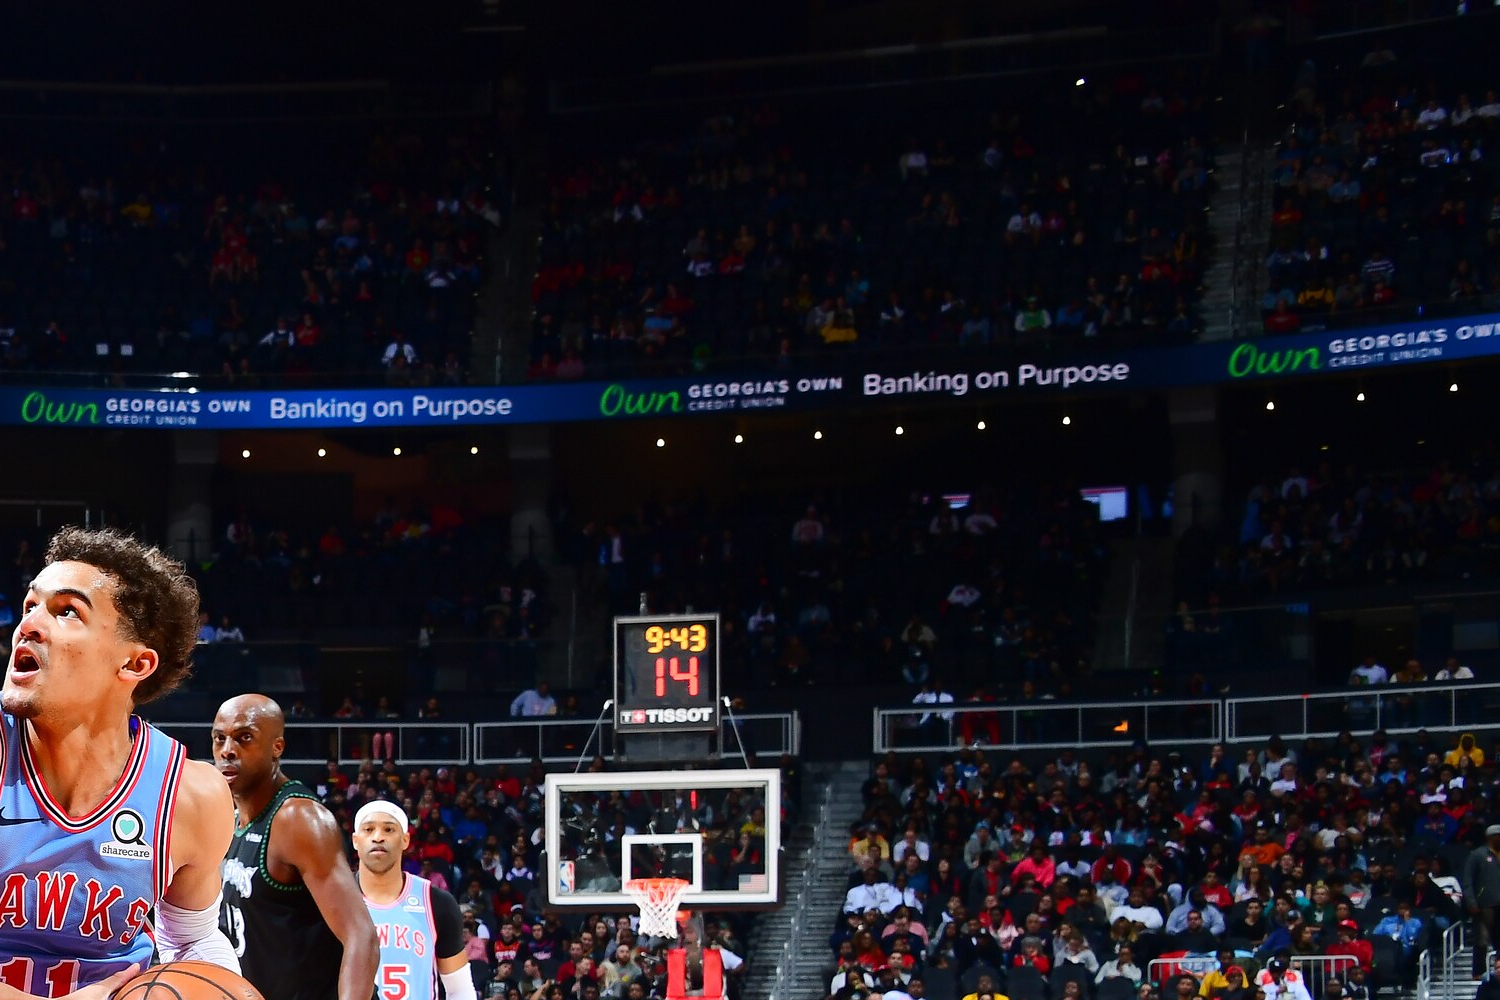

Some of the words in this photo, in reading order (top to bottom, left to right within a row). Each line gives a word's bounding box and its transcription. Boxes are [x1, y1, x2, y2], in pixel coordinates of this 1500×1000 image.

[1329, 327, 1448, 355] GEORGIA'S
[1228, 341, 1320, 379] Own
[1329, 351, 1382, 368] CREDIT
[1390, 346, 1443, 363] UNION
[688, 378, 791, 400] GEORGIA'S
[796, 376, 843, 393] OWN
[862, 368, 969, 398] Banking
[976, 367, 1009, 388] on
[1018, 358, 1130, 390] Purpose
[21, 391, 101, 425] Own
[106, 398, 201, 414] GEORGIA'S
[208, 399, 251, 413] OWN
[269, 397, 367, 423] Banking
[373, 400, 402, 418] on
[412, 395, 512, 420] Purpose
[599, 384, 681, 417] Own
[688, 400, 737, 412] CREDIT
[741, 396, 785, 408] UNION
[106, 414, 152, 426] CREDIT
[156, 413, 197, 426] UNION
[645, 624, 707, 653] 9:43
[654, 656, 699, 697] 14
[646, 707, 713, 723] TISSOT
[102, 845, 150, 858] sharecare
[375, 922, 426, 957] WKS
